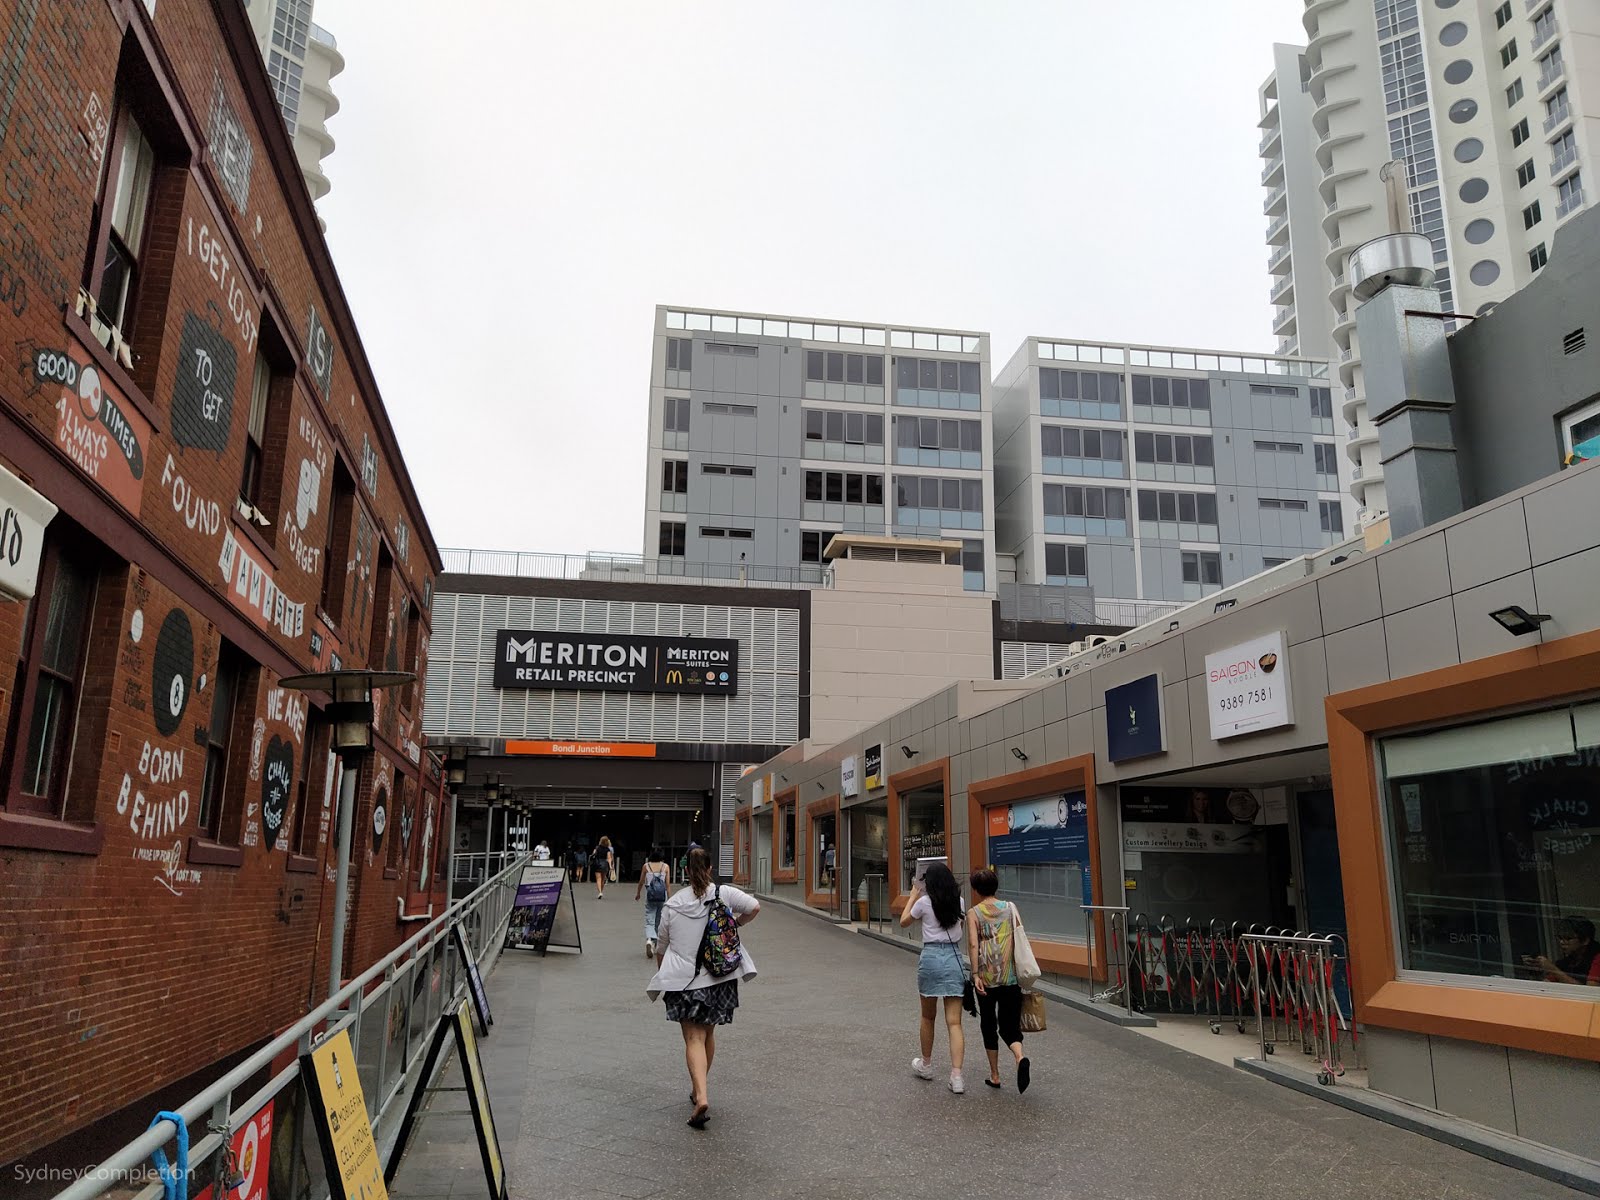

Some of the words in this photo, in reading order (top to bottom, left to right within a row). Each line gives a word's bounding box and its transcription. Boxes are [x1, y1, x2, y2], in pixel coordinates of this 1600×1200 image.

[199, 224, 229, 298] GET
[228, 277, 258, 354] LOST
[195, 348, 213, 386] TO
[38, 353, 77, 386] GOOD
[103, 398, 136, 460] TIMES
[202, 389, 224, 423] GET
[55, 396, 109, 460] ALWAYS
[299, 416, 327, 477] NEVER
[60, 428, 100, 478] USUALLY
[160, 453, 221, 537] FOUND
[283, 510, 321, 576] FORGET
[505, 636, 648, 669] MERITON
[667, 646, 729, 661] MERITON
[1209, 658, 1257, 683] SAIGON
[515, 667, 564, 681] RETAIL
[567, 669, 636, 684] PRECINCT
[1228, 672, 1257, 685] NOODLE
[267, 688, 283, 721] WE
[284, 692, 306, 745] ARE
[1219, 693, 1244, 712] 9389
[1247, 686, 1273, 706] 7581
[138, 740, 184, 785] BORN
[552, 743, 575, 753] Bondi
[576, 744, 611, 754] Junction
[267, 759, 290, 795] CHALK
[116, 773, 189, 840] BEHIND
[1125, 838, 1150, 847] Custom
[1151, 839, 1184, 849] Jewellery
[1185, 839, 1208, 849] Design
[340, 1141, 355, 1166] CELL
[352, 1121, 370, 1149] PHONE
